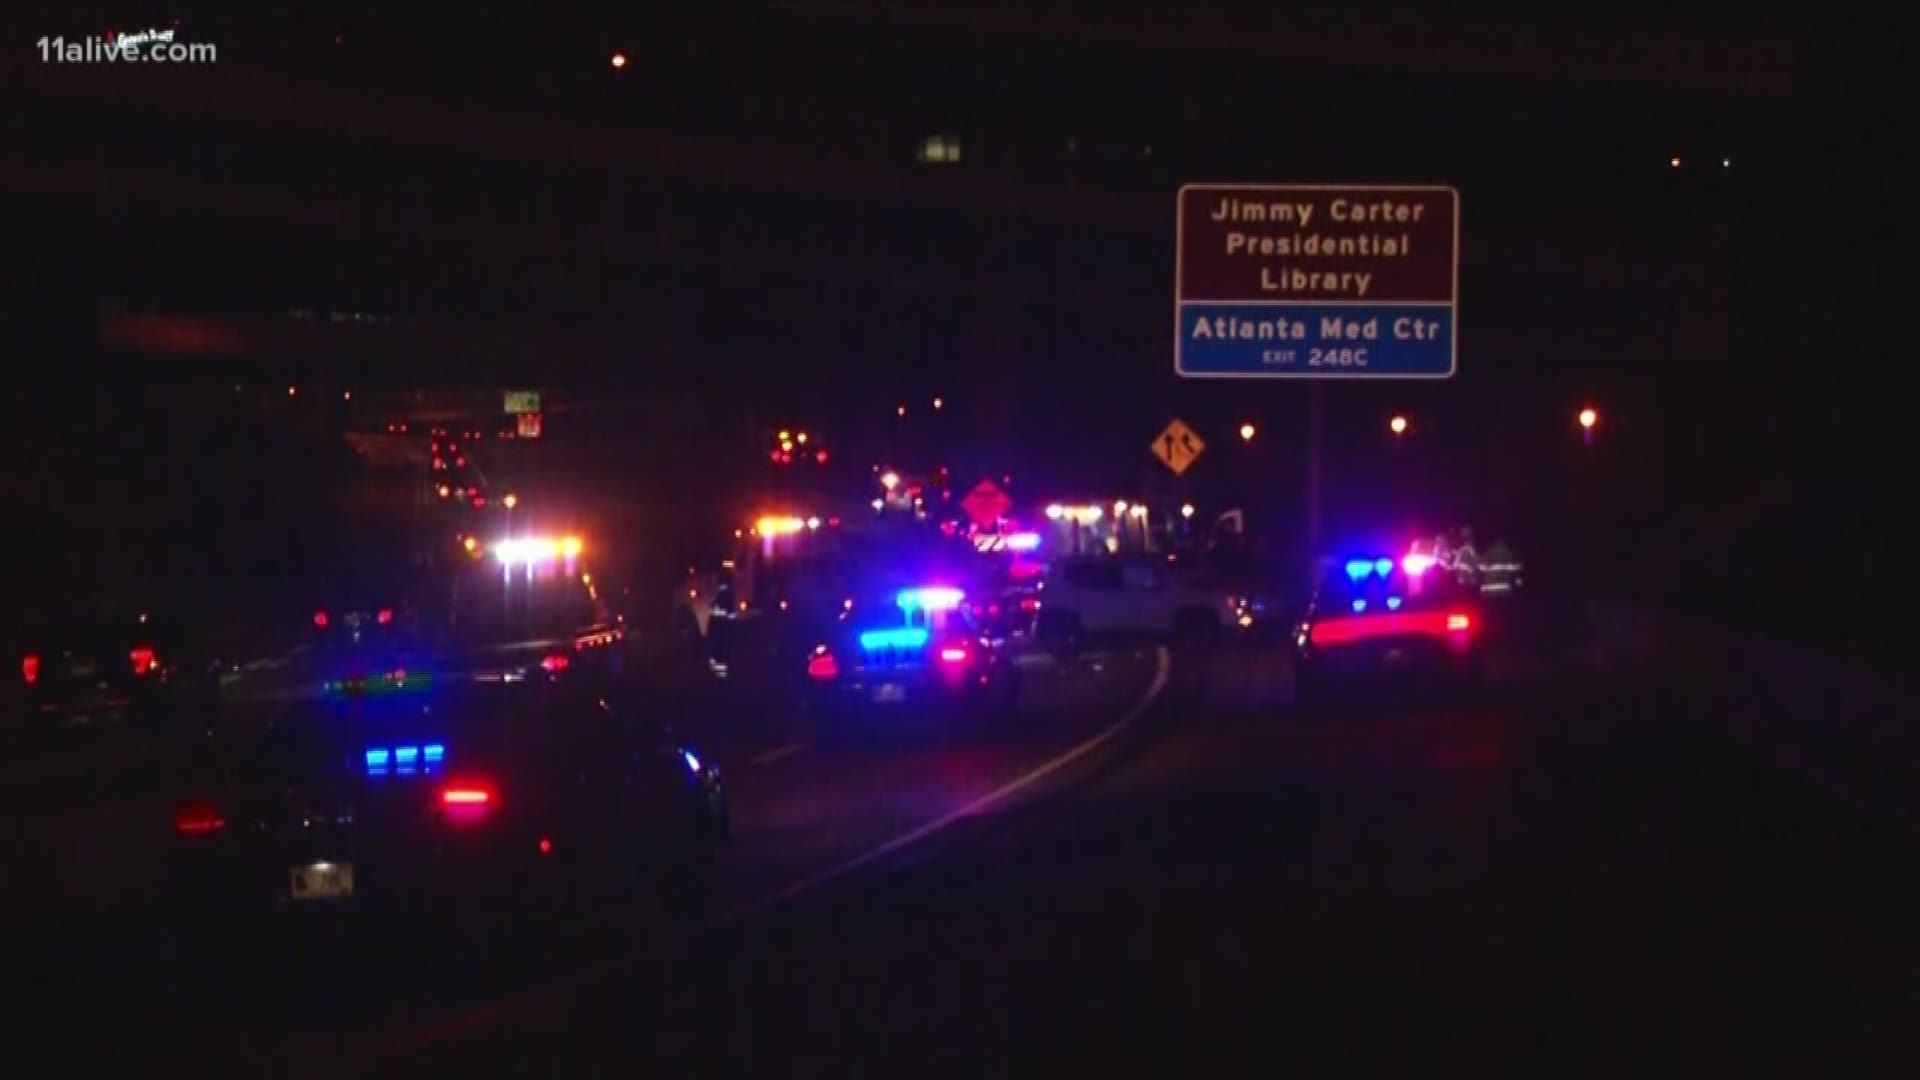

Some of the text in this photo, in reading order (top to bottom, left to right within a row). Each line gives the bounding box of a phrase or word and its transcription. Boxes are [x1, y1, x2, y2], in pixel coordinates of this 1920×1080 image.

[1211, 198, 1425, 226] Jimmy Carter
[1226, 233, 1410, 256] Presidential
[1261, 267, 1372, 296] Library
[1192, 316, 1441, 340] Atlanta Med Ctr
[1262, 348, 1368, 366] EXIT 248C
